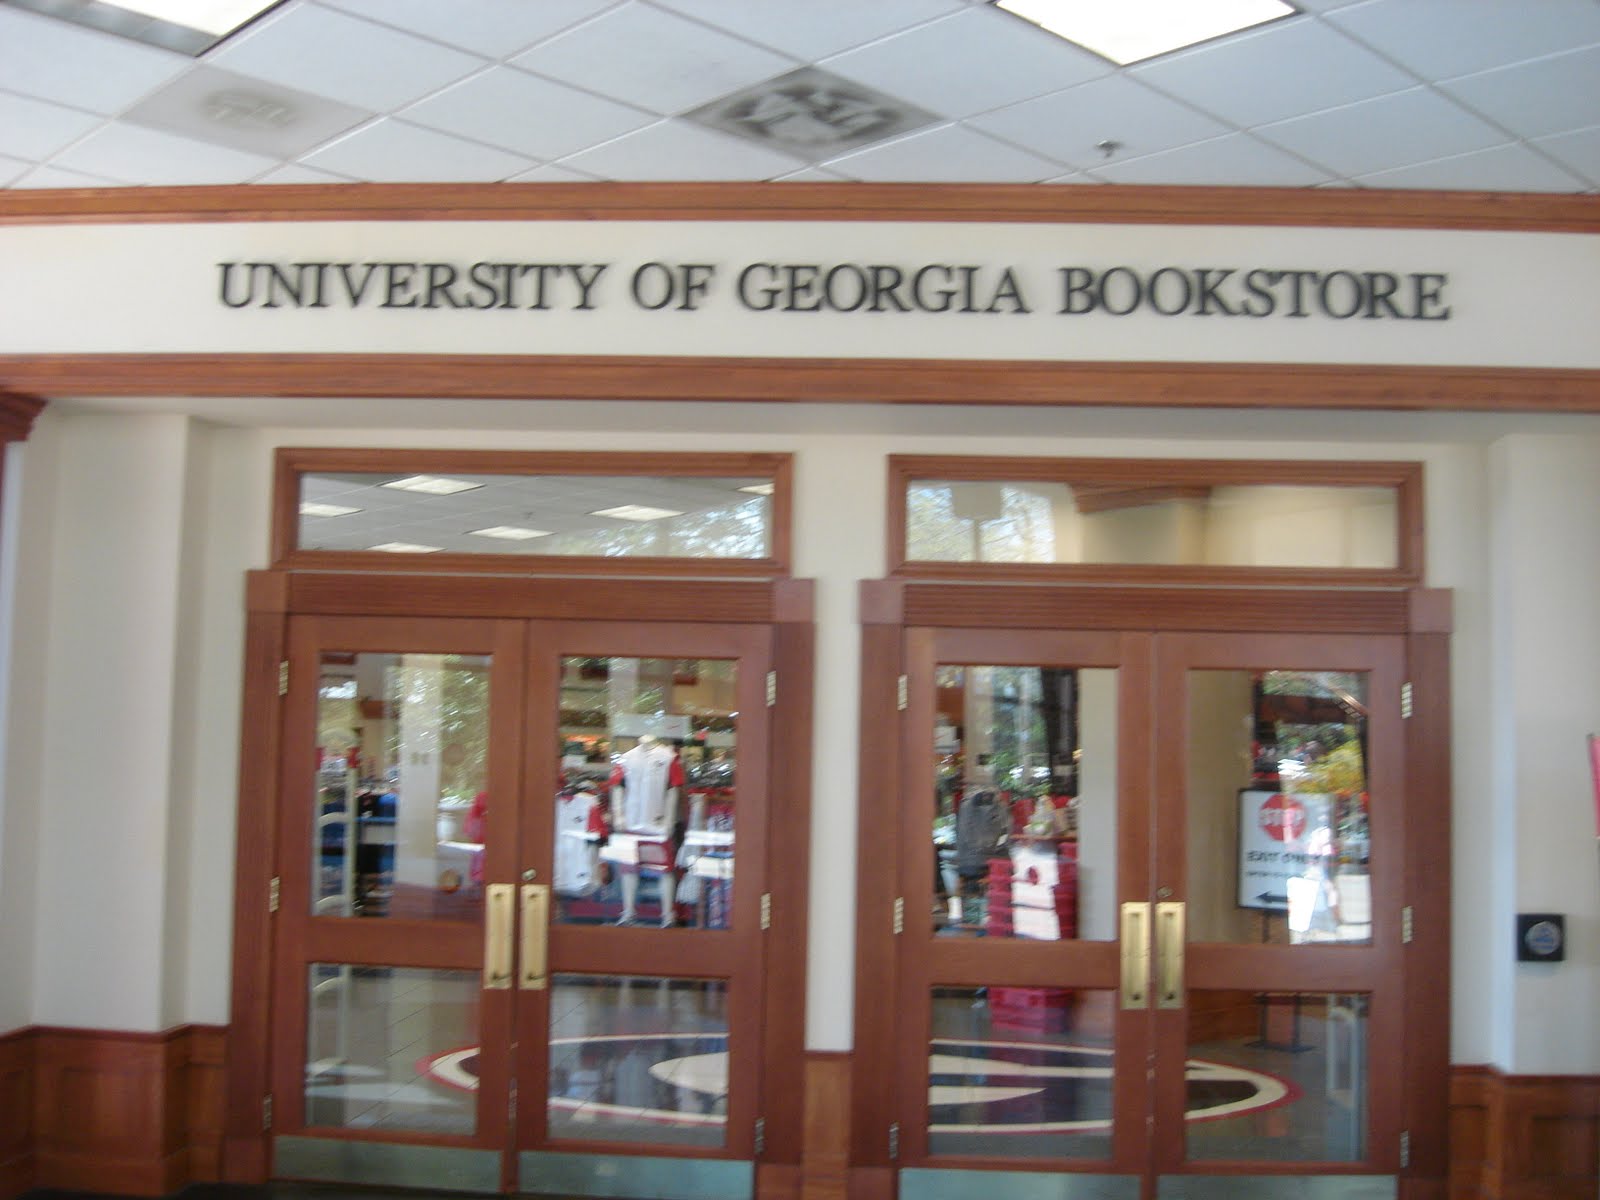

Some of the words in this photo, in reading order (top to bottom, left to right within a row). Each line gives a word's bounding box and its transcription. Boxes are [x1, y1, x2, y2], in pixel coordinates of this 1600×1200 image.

[218, 261, 608, 310] UNIVERSITY
[631, 262, 714, 311] OF
[737, 263, 1031, 314] GEORGIA
[1060, 267, 1450, 320] BOOKSTORE
